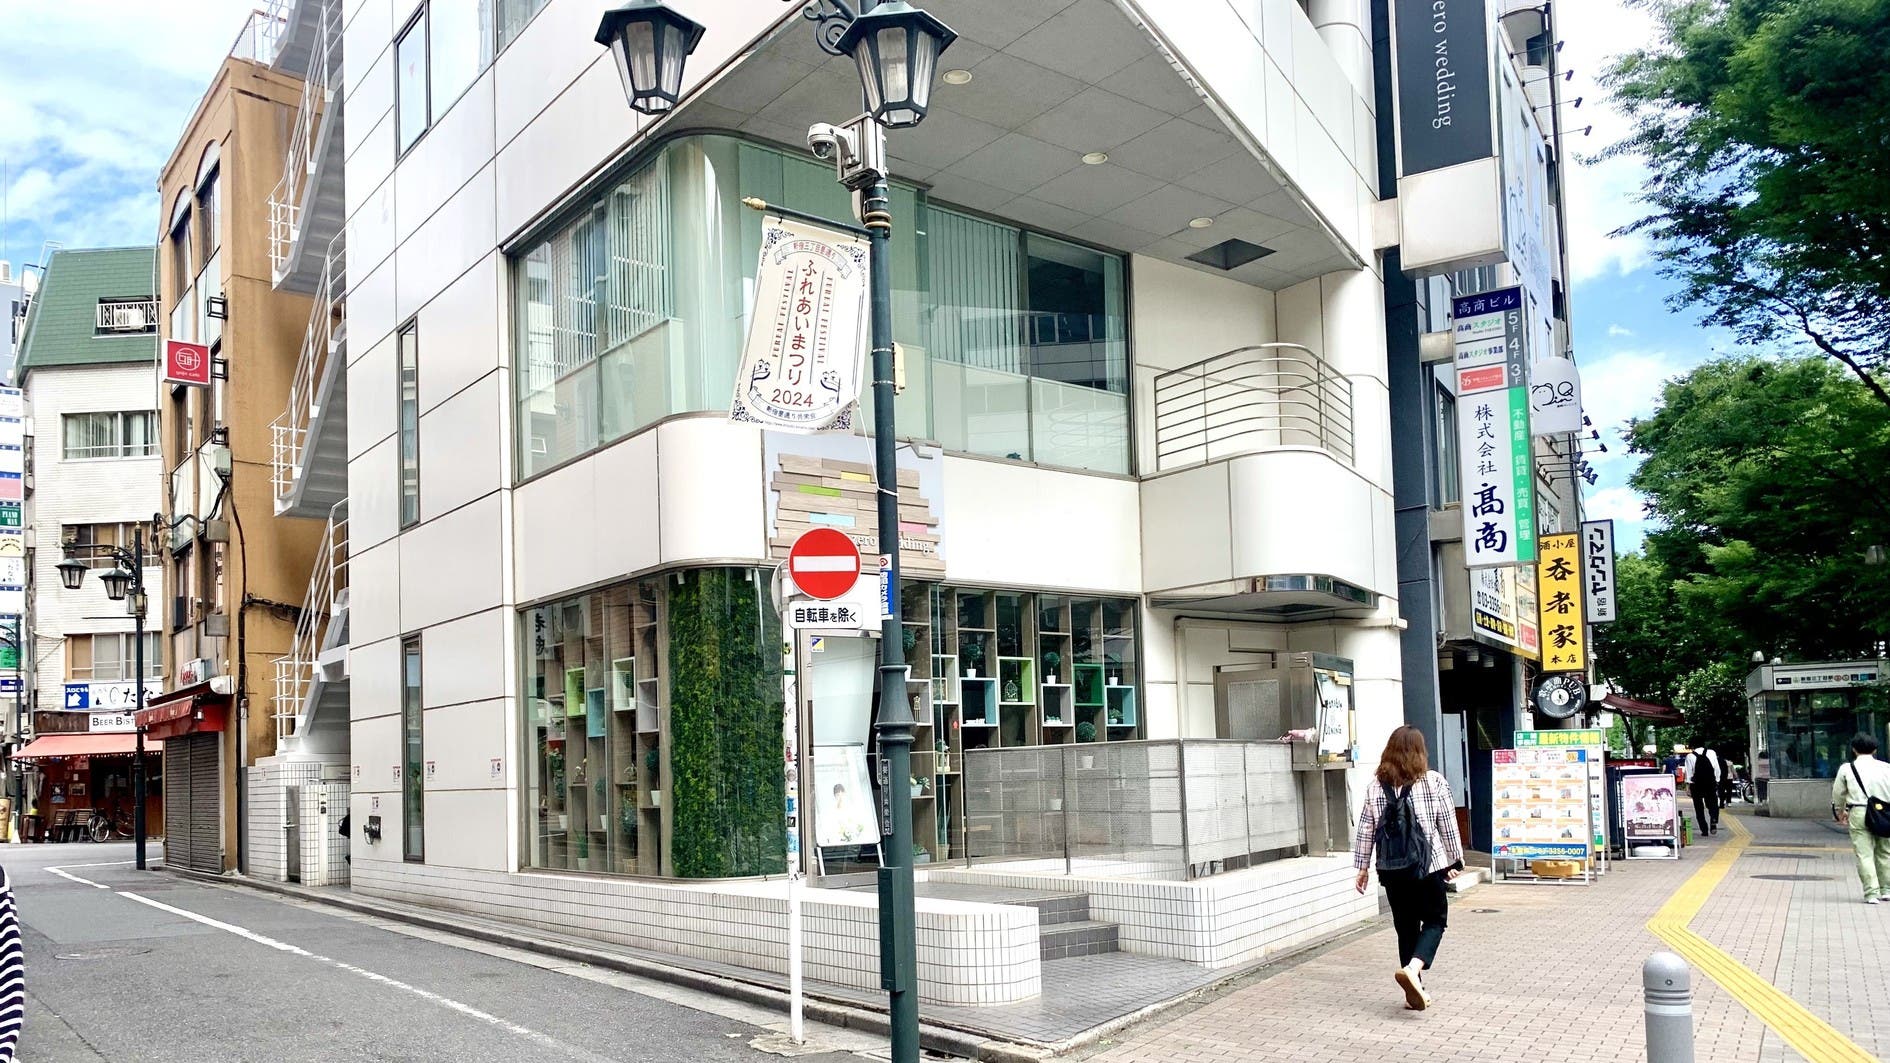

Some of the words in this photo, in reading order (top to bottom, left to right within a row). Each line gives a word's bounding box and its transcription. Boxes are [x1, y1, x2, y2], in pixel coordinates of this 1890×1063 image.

[1432, 39, 1456, 129] wedding
[789, 259, 817, 386] ふれあいまつり
[771, 388, 814, 408] 2024
[1474, 404, 1498, 476] 株式会社
[1588, 527, 1607, 597] ヤングマン
[795, 607, 857, 623] 自転車を除く
[1544, 557, 1577, 649] 呑者家
[1550, 654, 1577, 665] 本店
